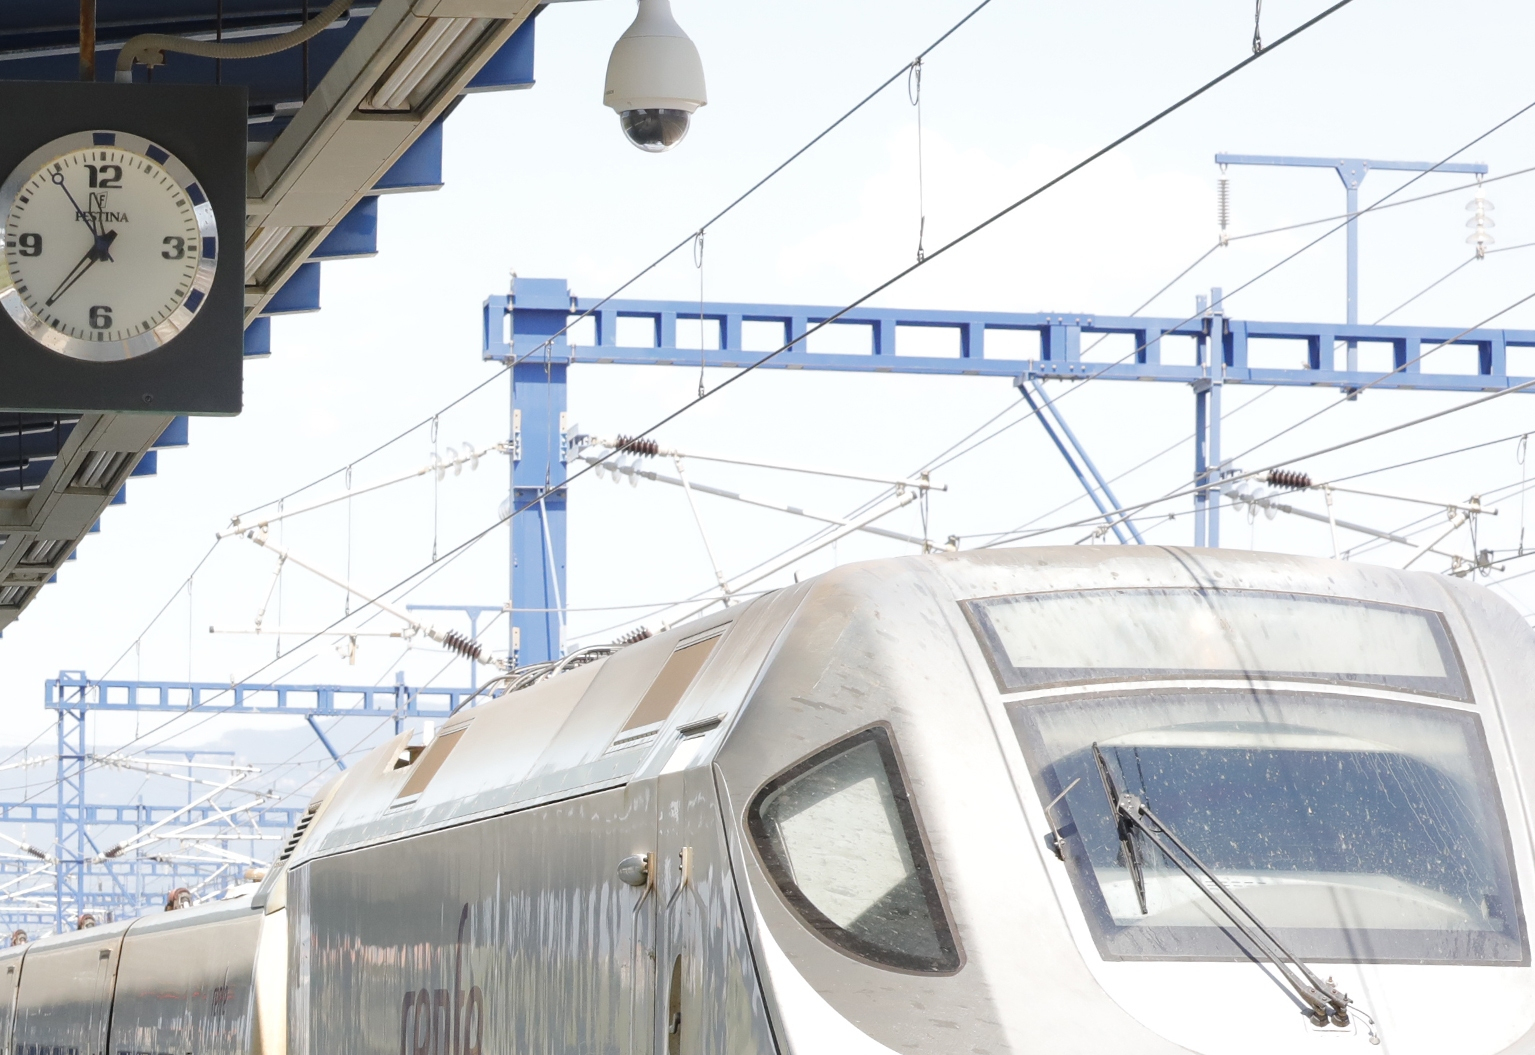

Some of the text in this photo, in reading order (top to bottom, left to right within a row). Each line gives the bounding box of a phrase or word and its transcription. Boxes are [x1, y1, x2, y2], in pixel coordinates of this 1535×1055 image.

[84, 164, 123, 189] 12
[18, 233, 43, 257] 9
[161, 236, 186, 260] 3
[88, 305, 113, 330] 6
